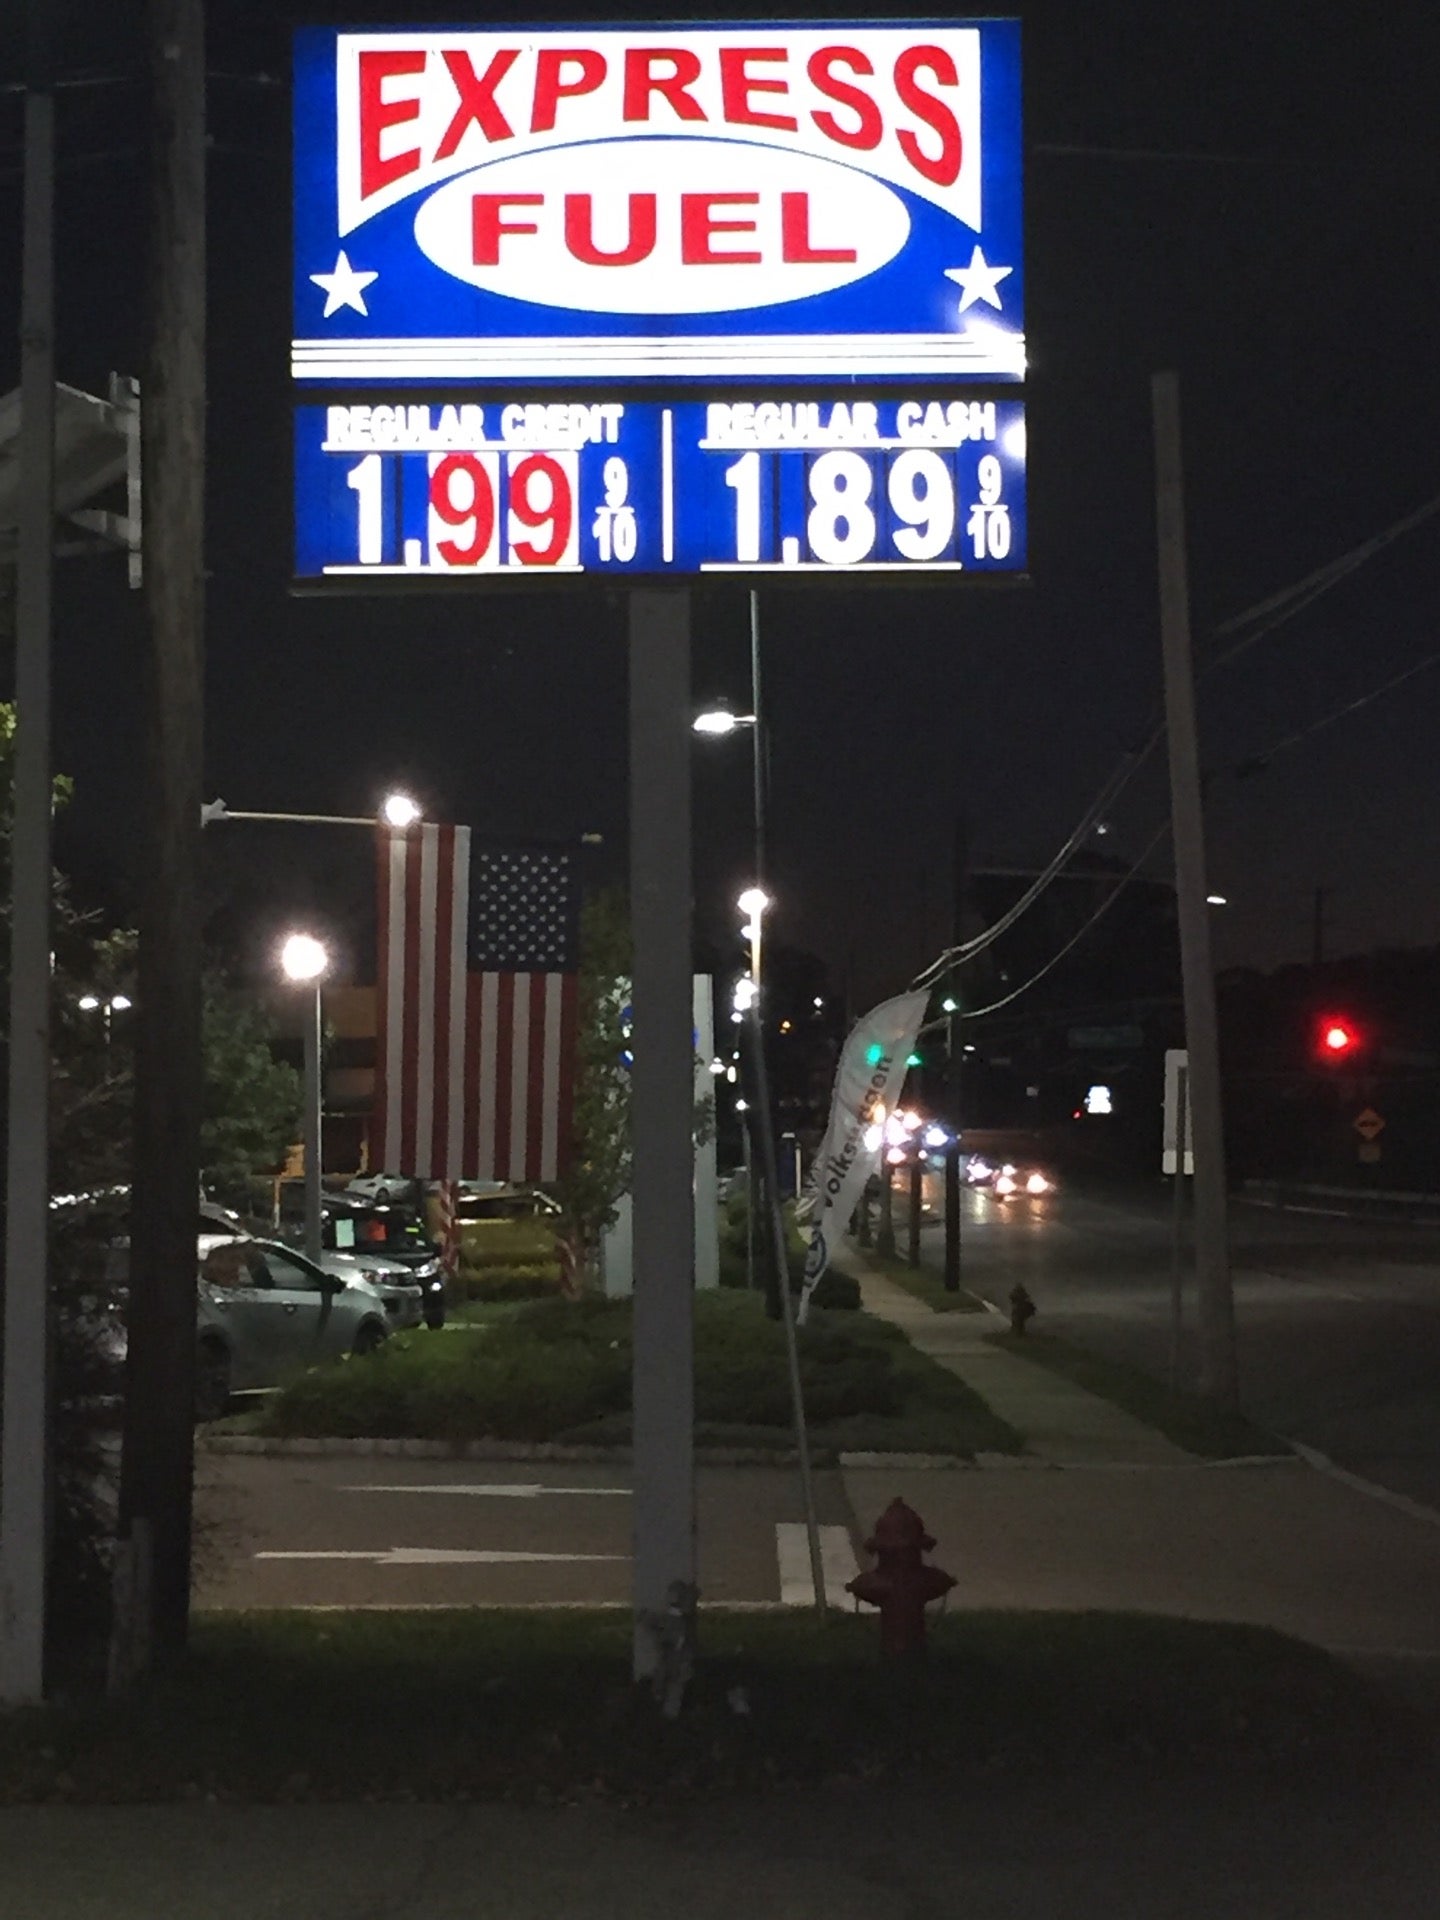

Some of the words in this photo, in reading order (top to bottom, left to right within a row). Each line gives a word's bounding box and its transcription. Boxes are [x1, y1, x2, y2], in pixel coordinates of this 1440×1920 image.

[358, 44, 963, 201] EXPRESS
[471, 192, 857, 266] FUEL
[326, 405, 486, 443] REGULAR
[501, 403, 624, 443] CREDIT
[706, 402, 881, 441] REGULAR
[896, 402, 996, 441] CASH
[347, 452, 574, 566] 1.99
[725, 449, 955, 565] 1.89
